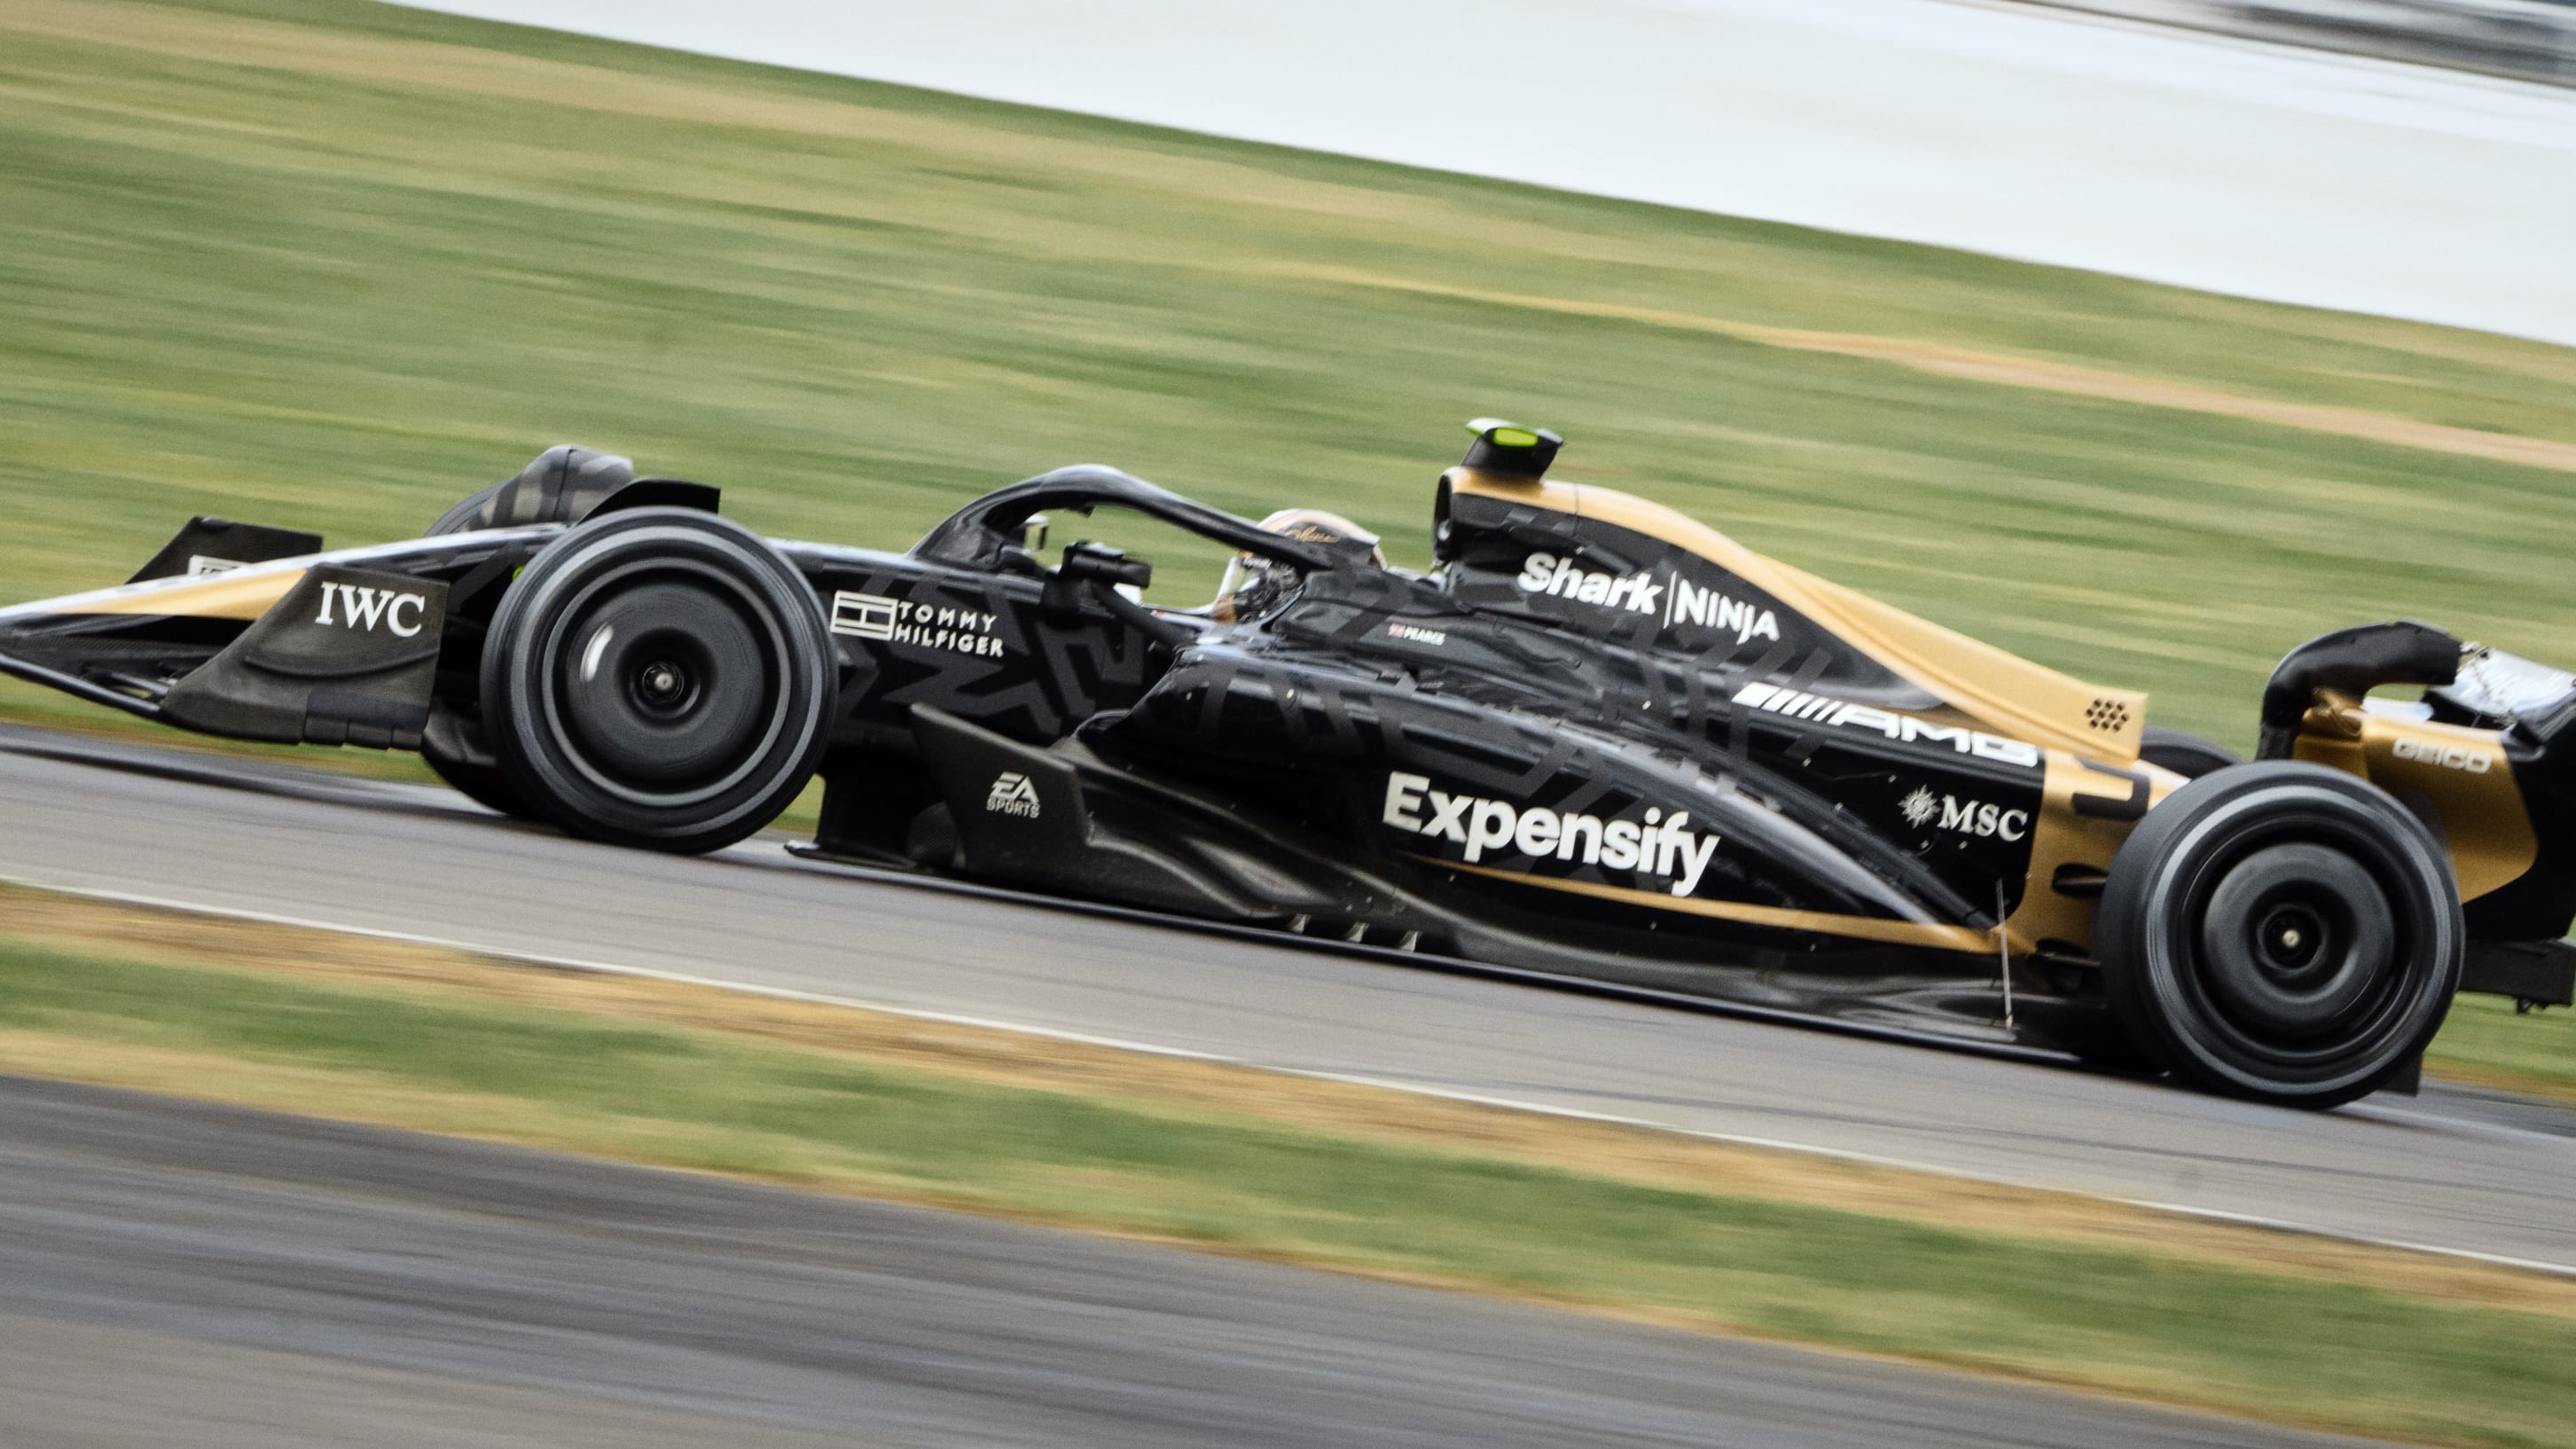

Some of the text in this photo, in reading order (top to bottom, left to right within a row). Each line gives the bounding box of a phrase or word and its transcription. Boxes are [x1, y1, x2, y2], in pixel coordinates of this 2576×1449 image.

[315, 581, 426, 638] IWC
[898, 600, 997, 633] TOMMY
[1517, 552, 1781, 646] Shark NINJA
[894, 623, 1004, 658] HILFIGER
[1827, 702, 2039, 768] AMG
[2392, 738, 2493, 774] GEICO
[986, 796, 1041, 818] SPORTS
[990, 771, 1040, 803] EA
[1382, 771, 1721, 897] Expensify
[1937, 795, 2029, 842] MSC
